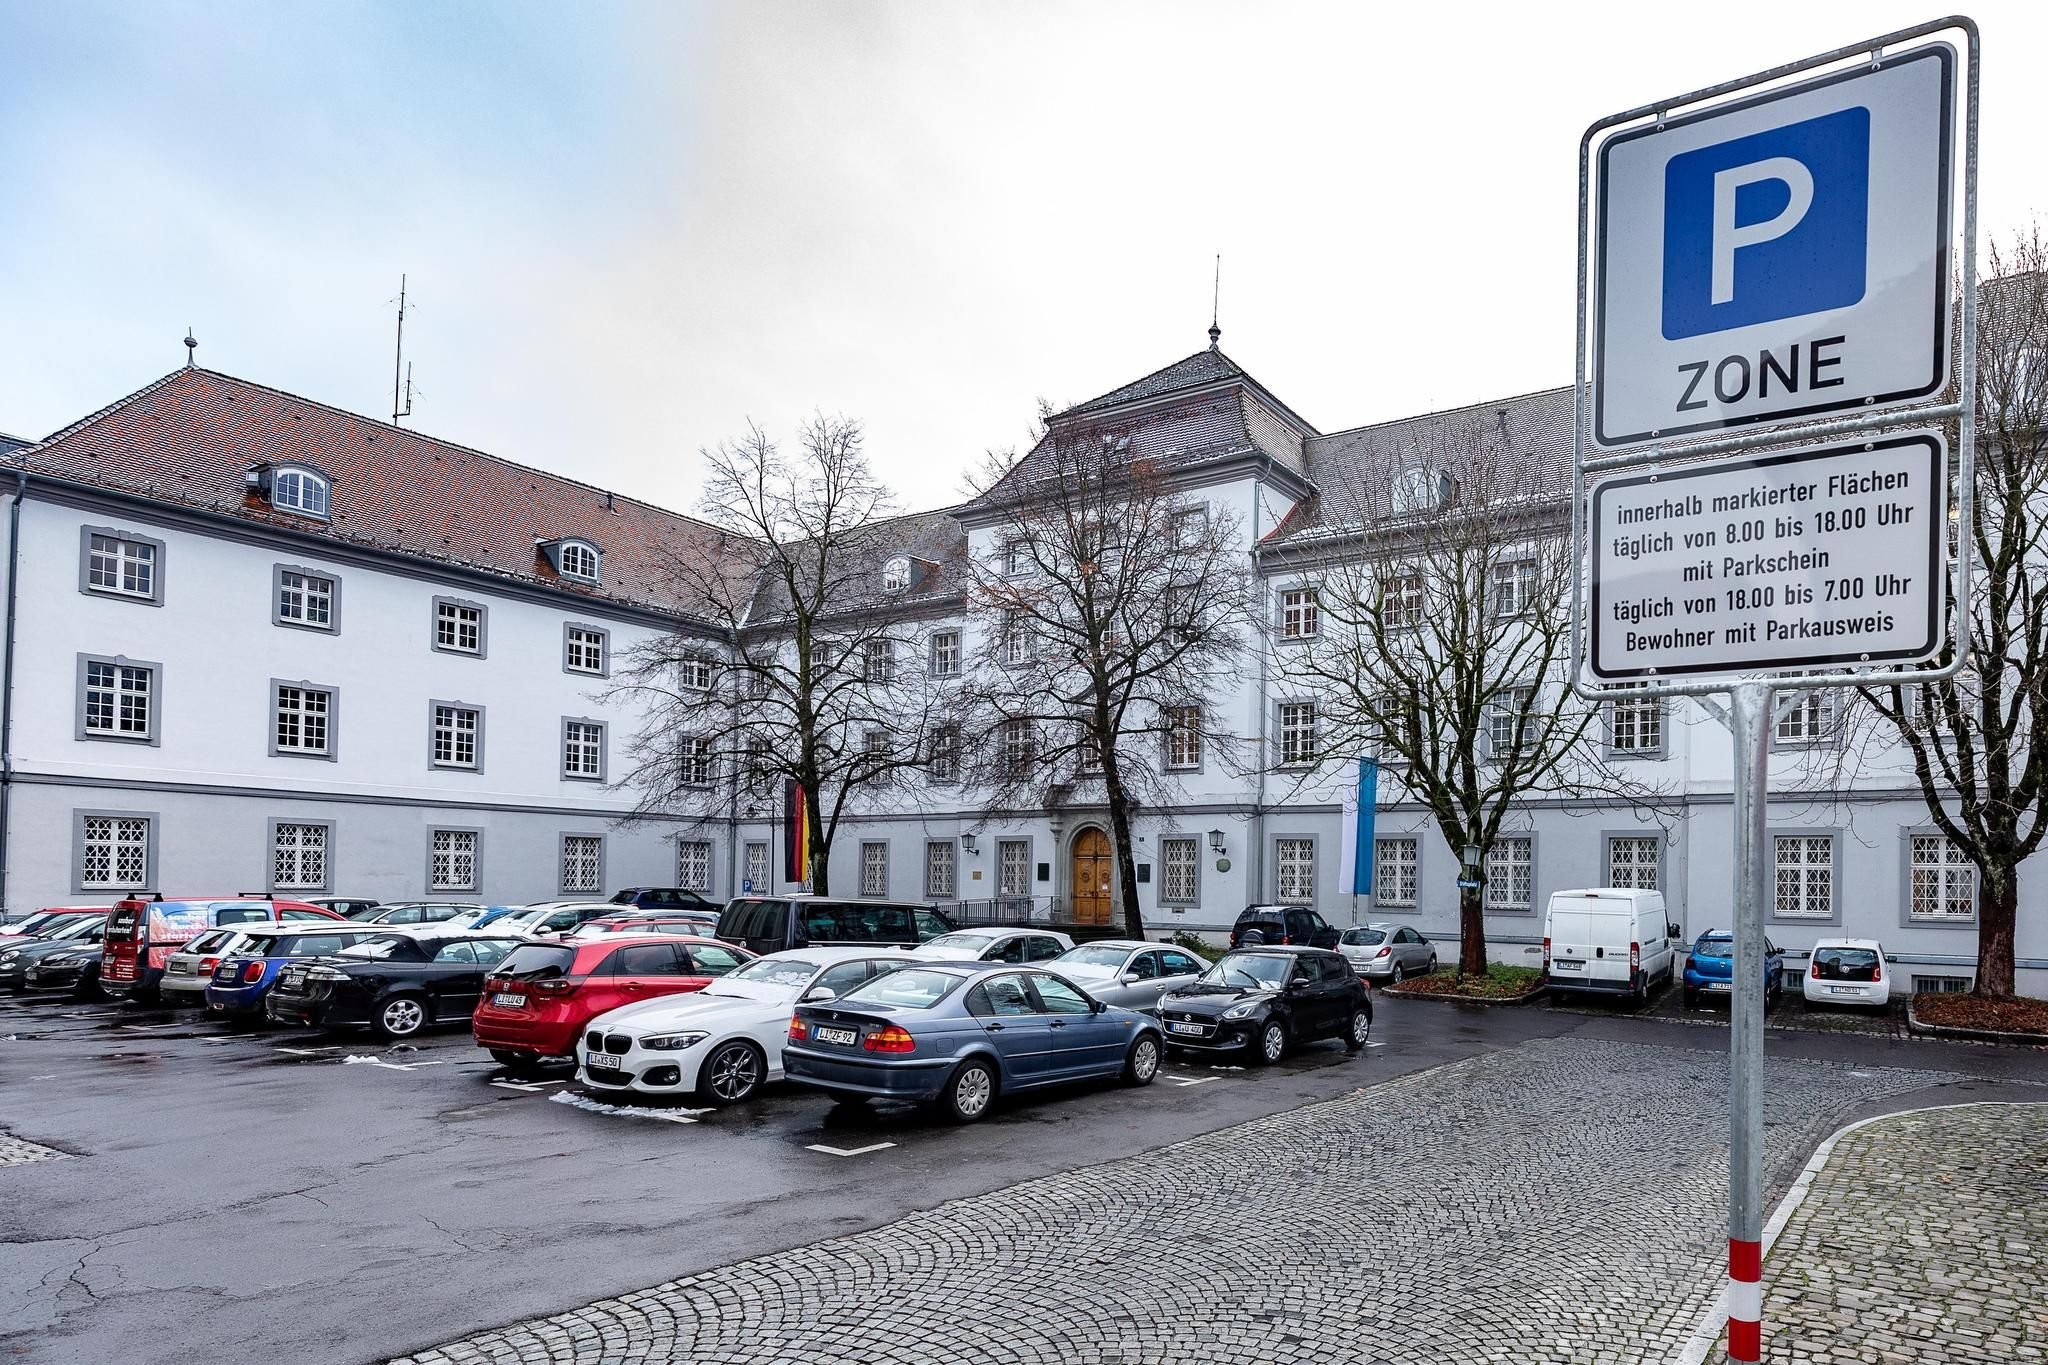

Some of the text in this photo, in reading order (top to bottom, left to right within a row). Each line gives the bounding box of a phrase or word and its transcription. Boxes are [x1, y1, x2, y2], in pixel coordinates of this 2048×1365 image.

[1711, 156, 1814, 305] P
[1676, 335, 1846, 412] ZONE
[1618, 471, 1909, 525] innerhalb markierter Flächen
[1613, 503, 1914, 560] täglich von 8.00 bis 18.00 Uhr
[1683, 548, 1829, 582] mit Parkschein
[1613, 573, 1912, 625] täglich von 18.00 bis 7.00 Uhr
[1626, 611, 1894, 652] Bewohner mit Parkausweis
[590, 1054, 618, 1067] LI XS 50
[819, 1030, 853, 1043] LI ZF 92
